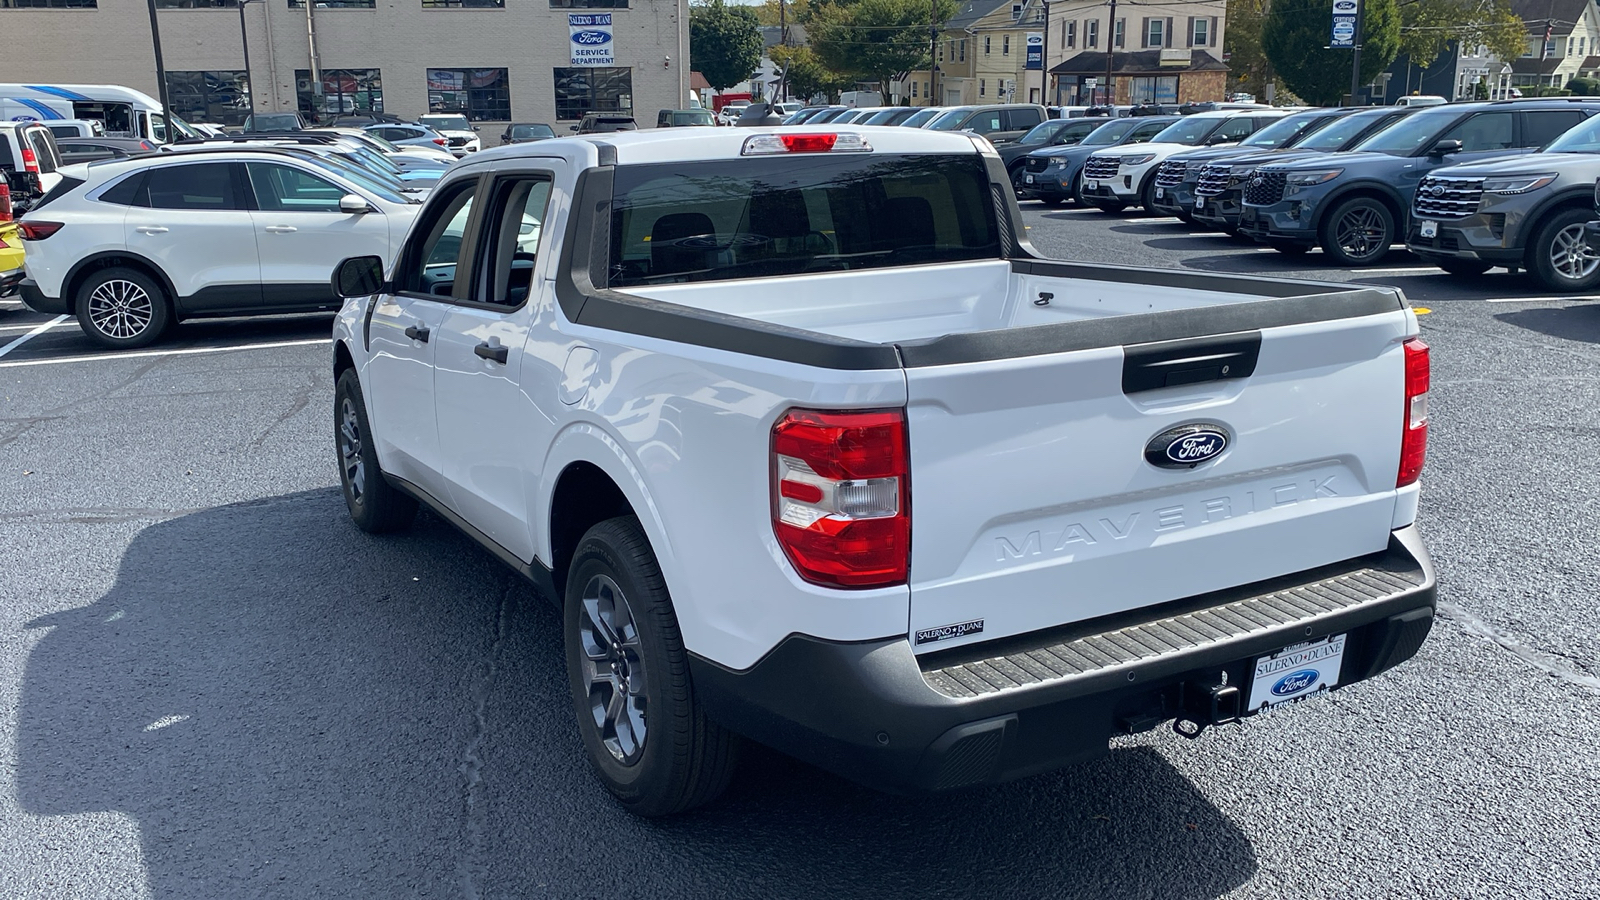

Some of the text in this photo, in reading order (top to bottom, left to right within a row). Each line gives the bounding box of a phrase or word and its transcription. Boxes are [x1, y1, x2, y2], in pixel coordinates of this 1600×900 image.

[569, 15, 611, 25] SALERNO DUANE
[578, 32, 605, 43] Ford
[1179, 435, 1215, 459] Ford
[995, 474, 1339, 562] MAVERICK
[918, 620, 983, 640] SALERNO DUANE
[1256, 642, 1342, 676] SALERNO DUANE
[1280, 673, 1311, 693] Ford
[1258, 687, 1331, 714] SALERNO DUANE
